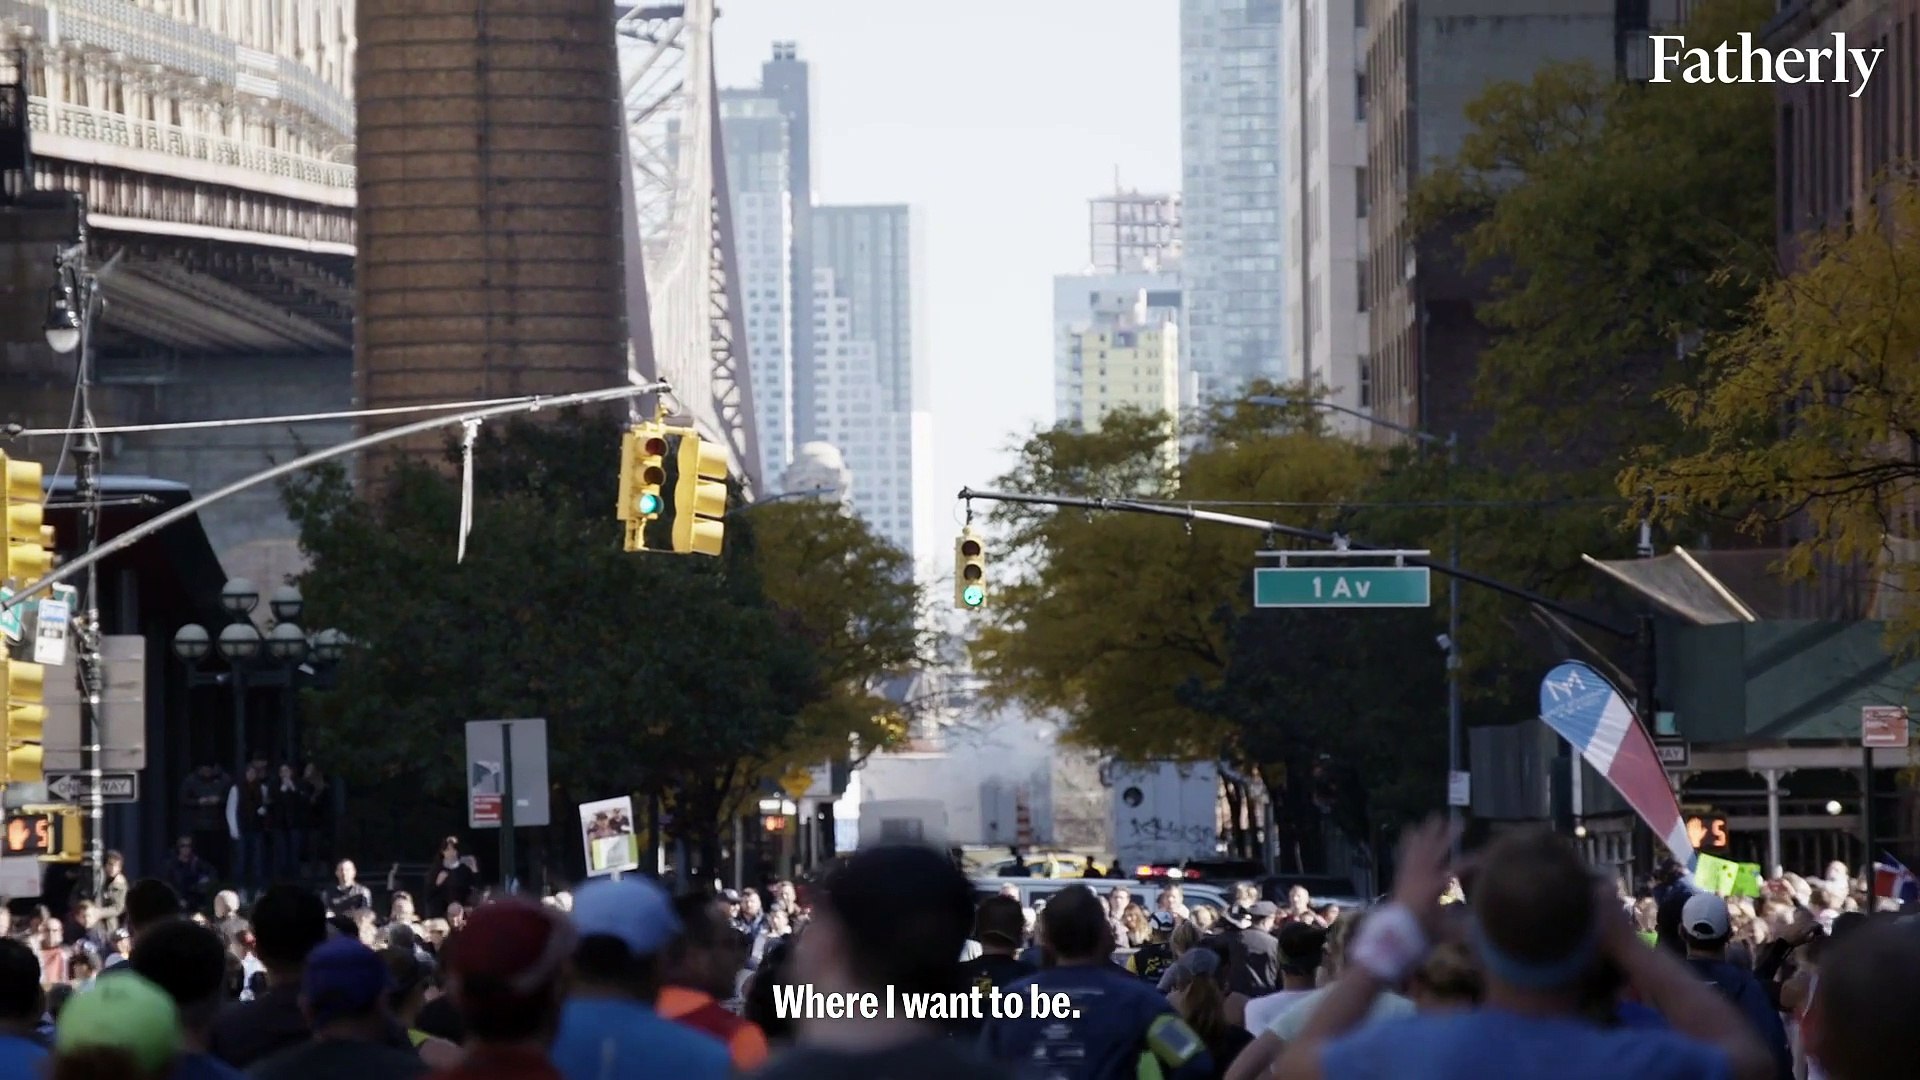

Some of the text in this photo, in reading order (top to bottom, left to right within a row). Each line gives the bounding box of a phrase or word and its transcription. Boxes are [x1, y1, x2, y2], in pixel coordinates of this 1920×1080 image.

[1312, 576, 1371, 598] 1 Av
[1712, 819, 1726, 847] 5
